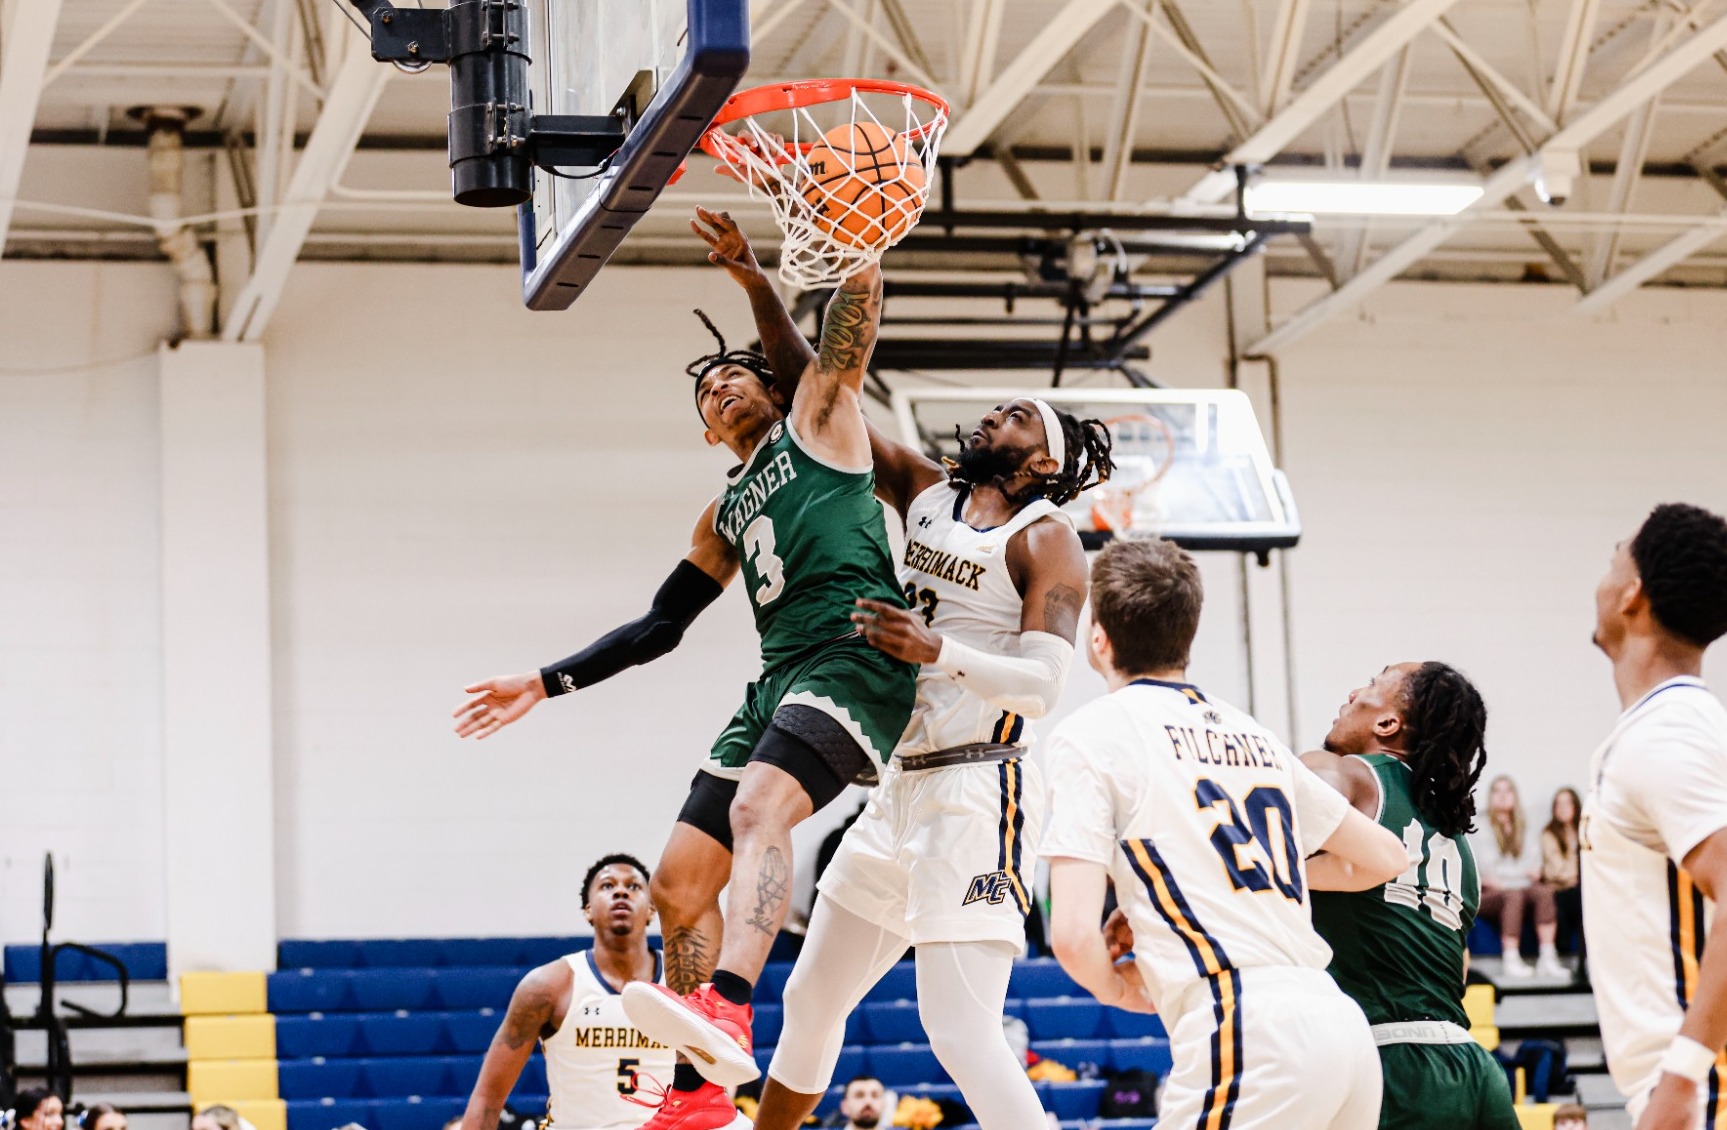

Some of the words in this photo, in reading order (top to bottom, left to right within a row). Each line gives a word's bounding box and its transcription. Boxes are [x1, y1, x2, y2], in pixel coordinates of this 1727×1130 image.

[719, 451, 797, 547] WAGNER
[743, 515, 786, 607] 3
[903, 539, 986, 591] ERRIMACK
[1192, 776, 1304, 910] 20
[1384, 818, 1463, 931] 10
[962, 871, 1012, 906] MC
[575, 1027, 669, 1049] MERRIM
[617, 1058, 640, 1095] 5
